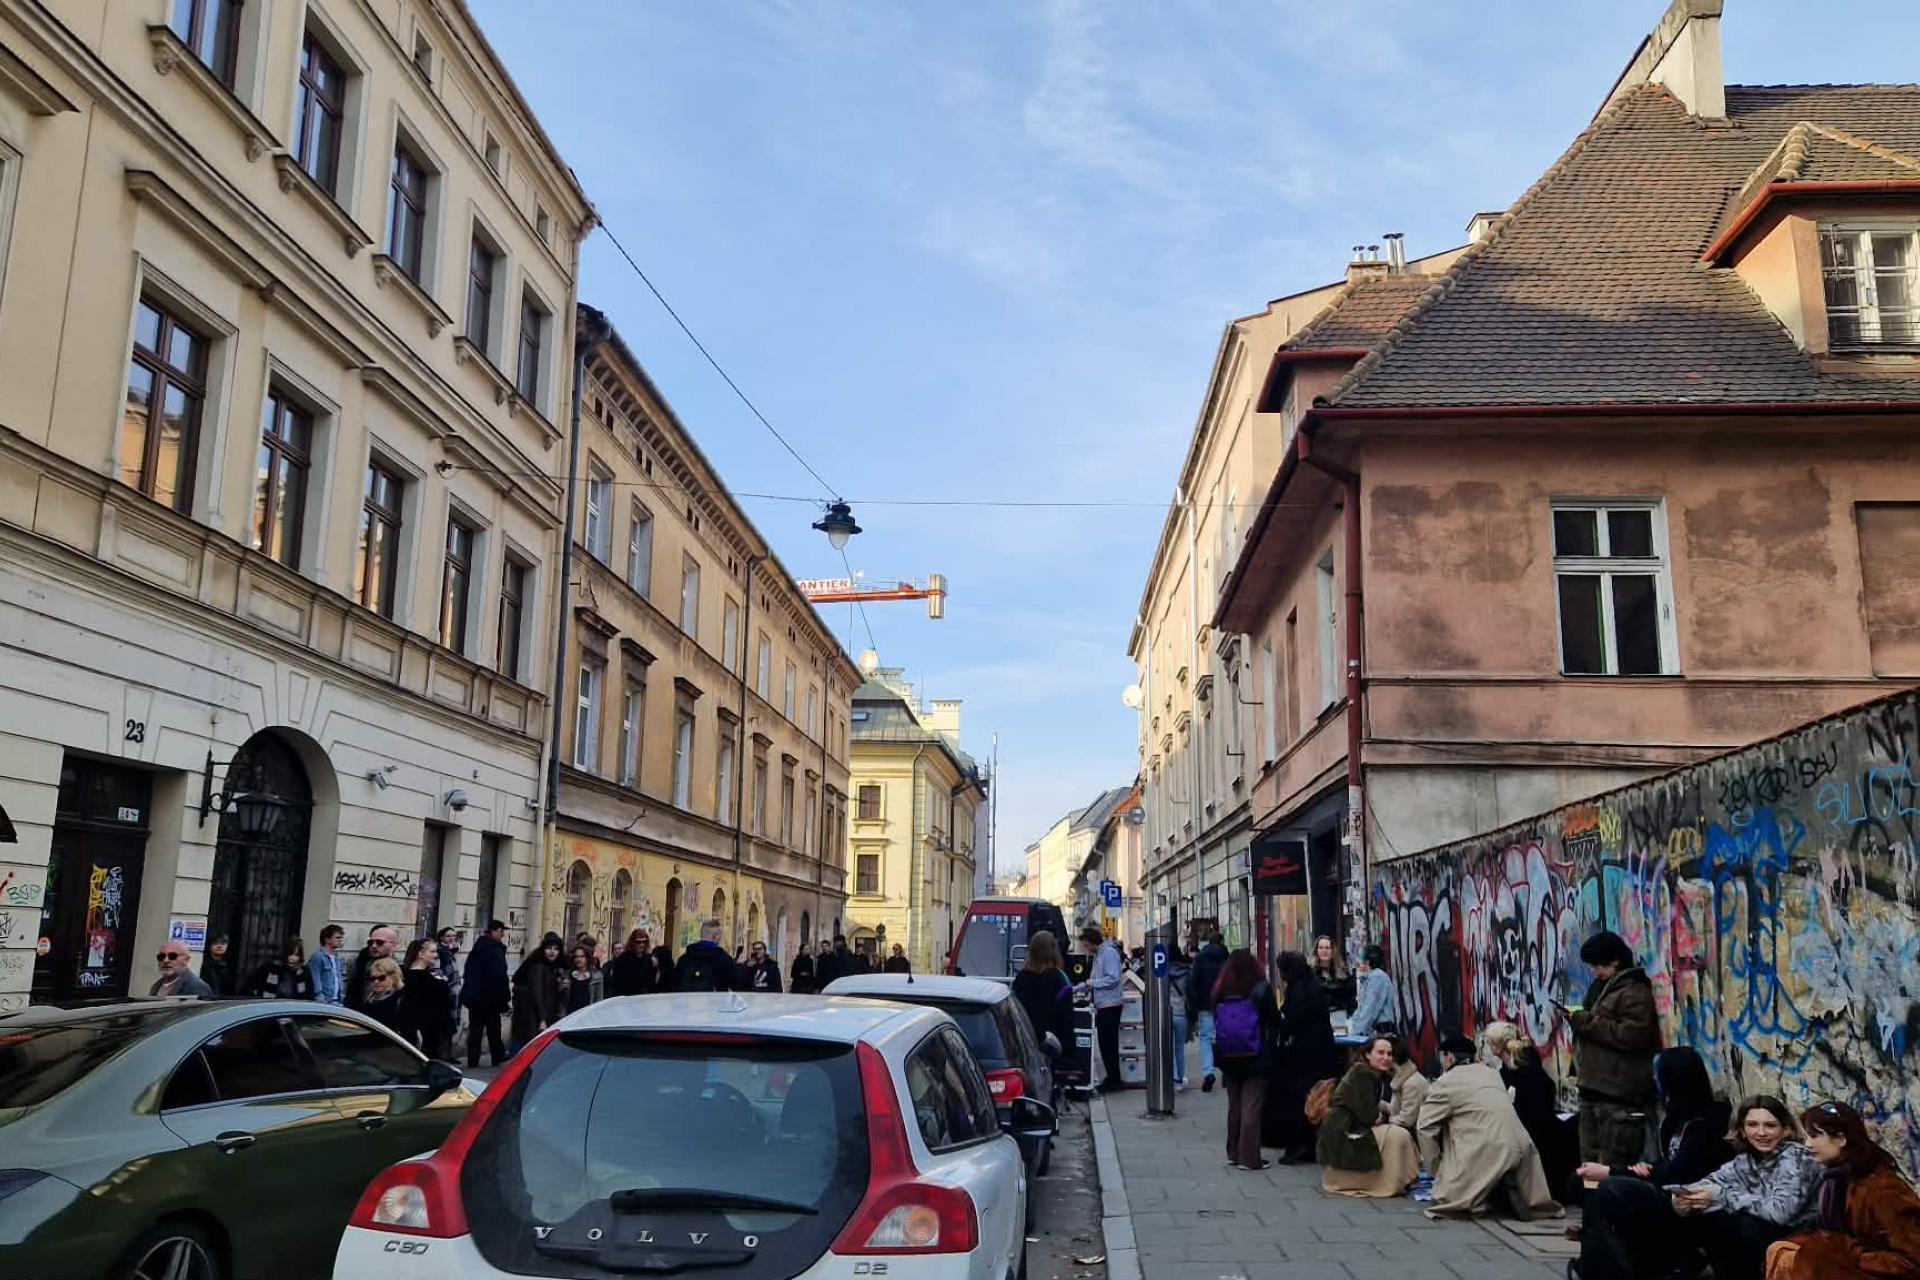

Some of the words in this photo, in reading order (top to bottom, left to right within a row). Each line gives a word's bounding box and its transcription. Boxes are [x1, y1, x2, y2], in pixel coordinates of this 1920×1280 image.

[125, 719, 145, 743] 23
[1108, 887, 1119, 901] P
[1154, 952, 1166, 969] P
[533, 1226, 760, 1248] VOLVO
[384, 1240, 430, 1255] C30
[854, 1262, 889, 1275] D2
